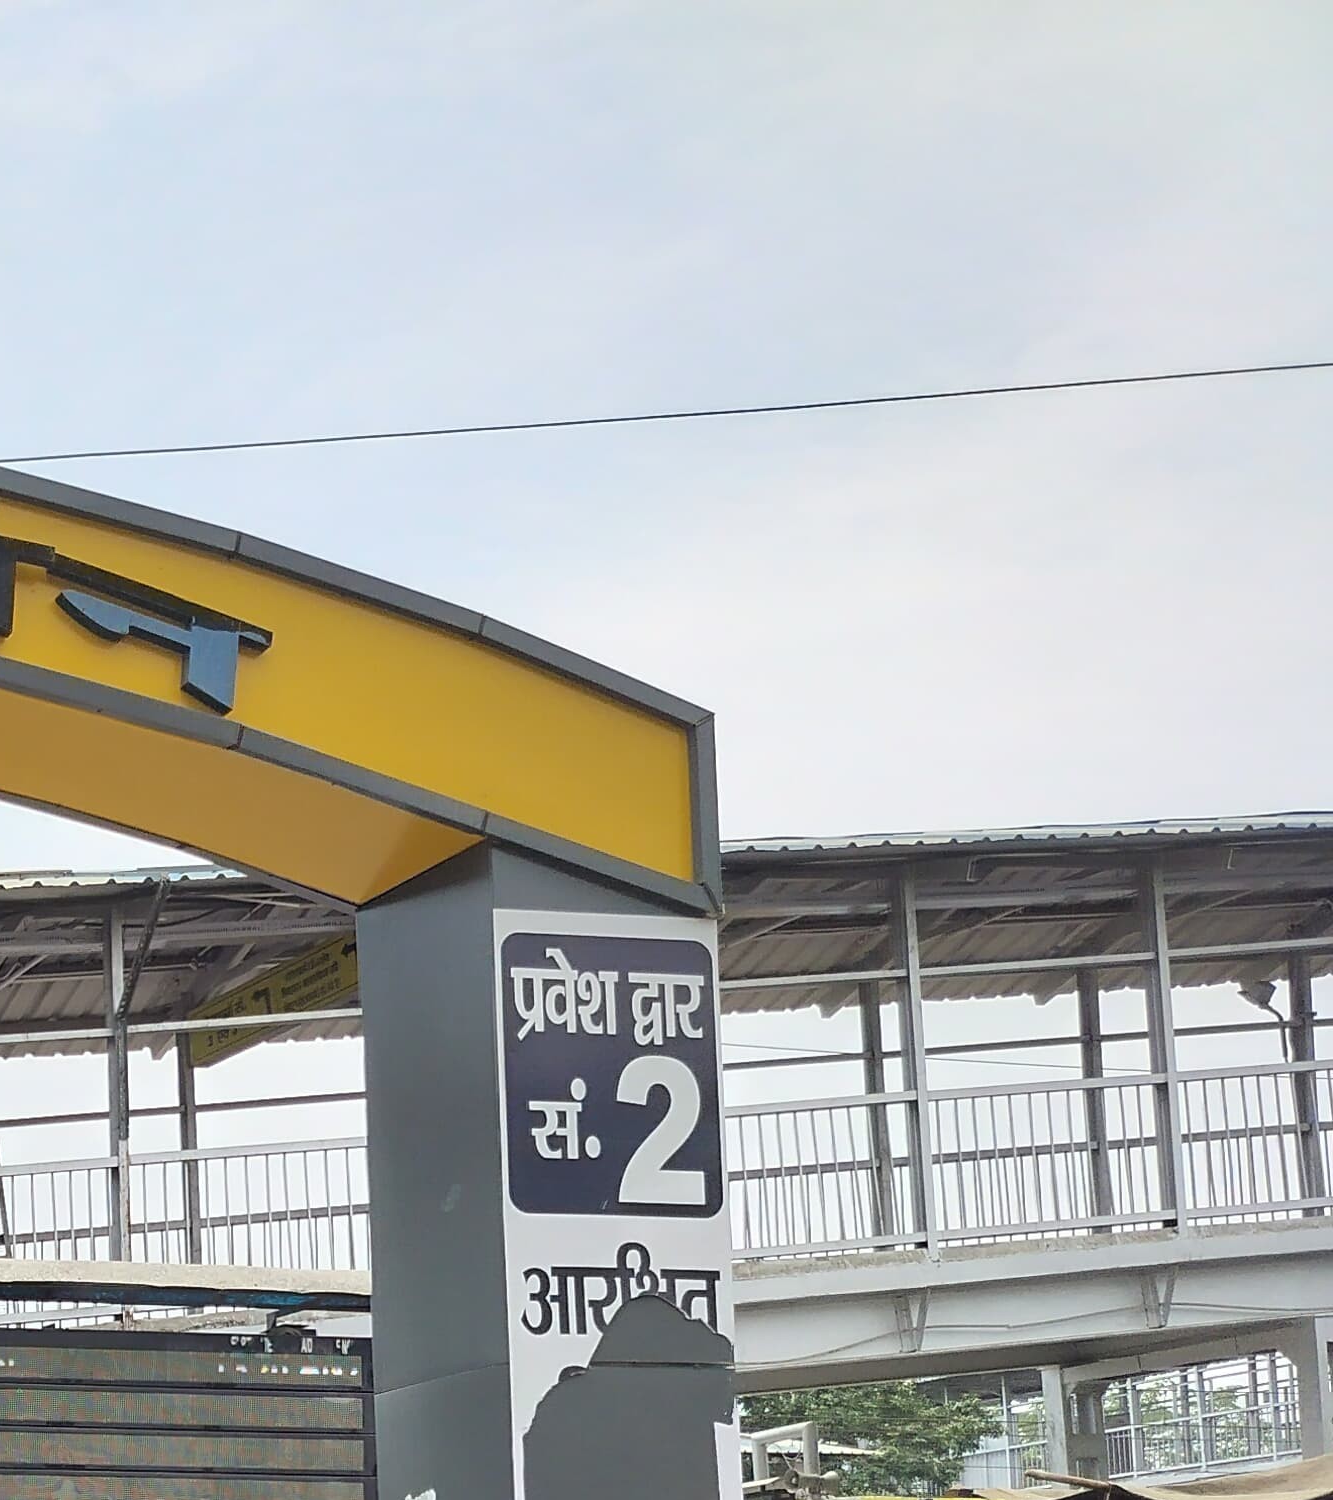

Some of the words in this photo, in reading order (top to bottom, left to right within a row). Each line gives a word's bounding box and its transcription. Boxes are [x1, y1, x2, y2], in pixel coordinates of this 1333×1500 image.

[509, 948, 620, 1040] प्रवेश
[627, 972, 705, 1046] द्वार
[616, 1055, 706, 1206] 2
